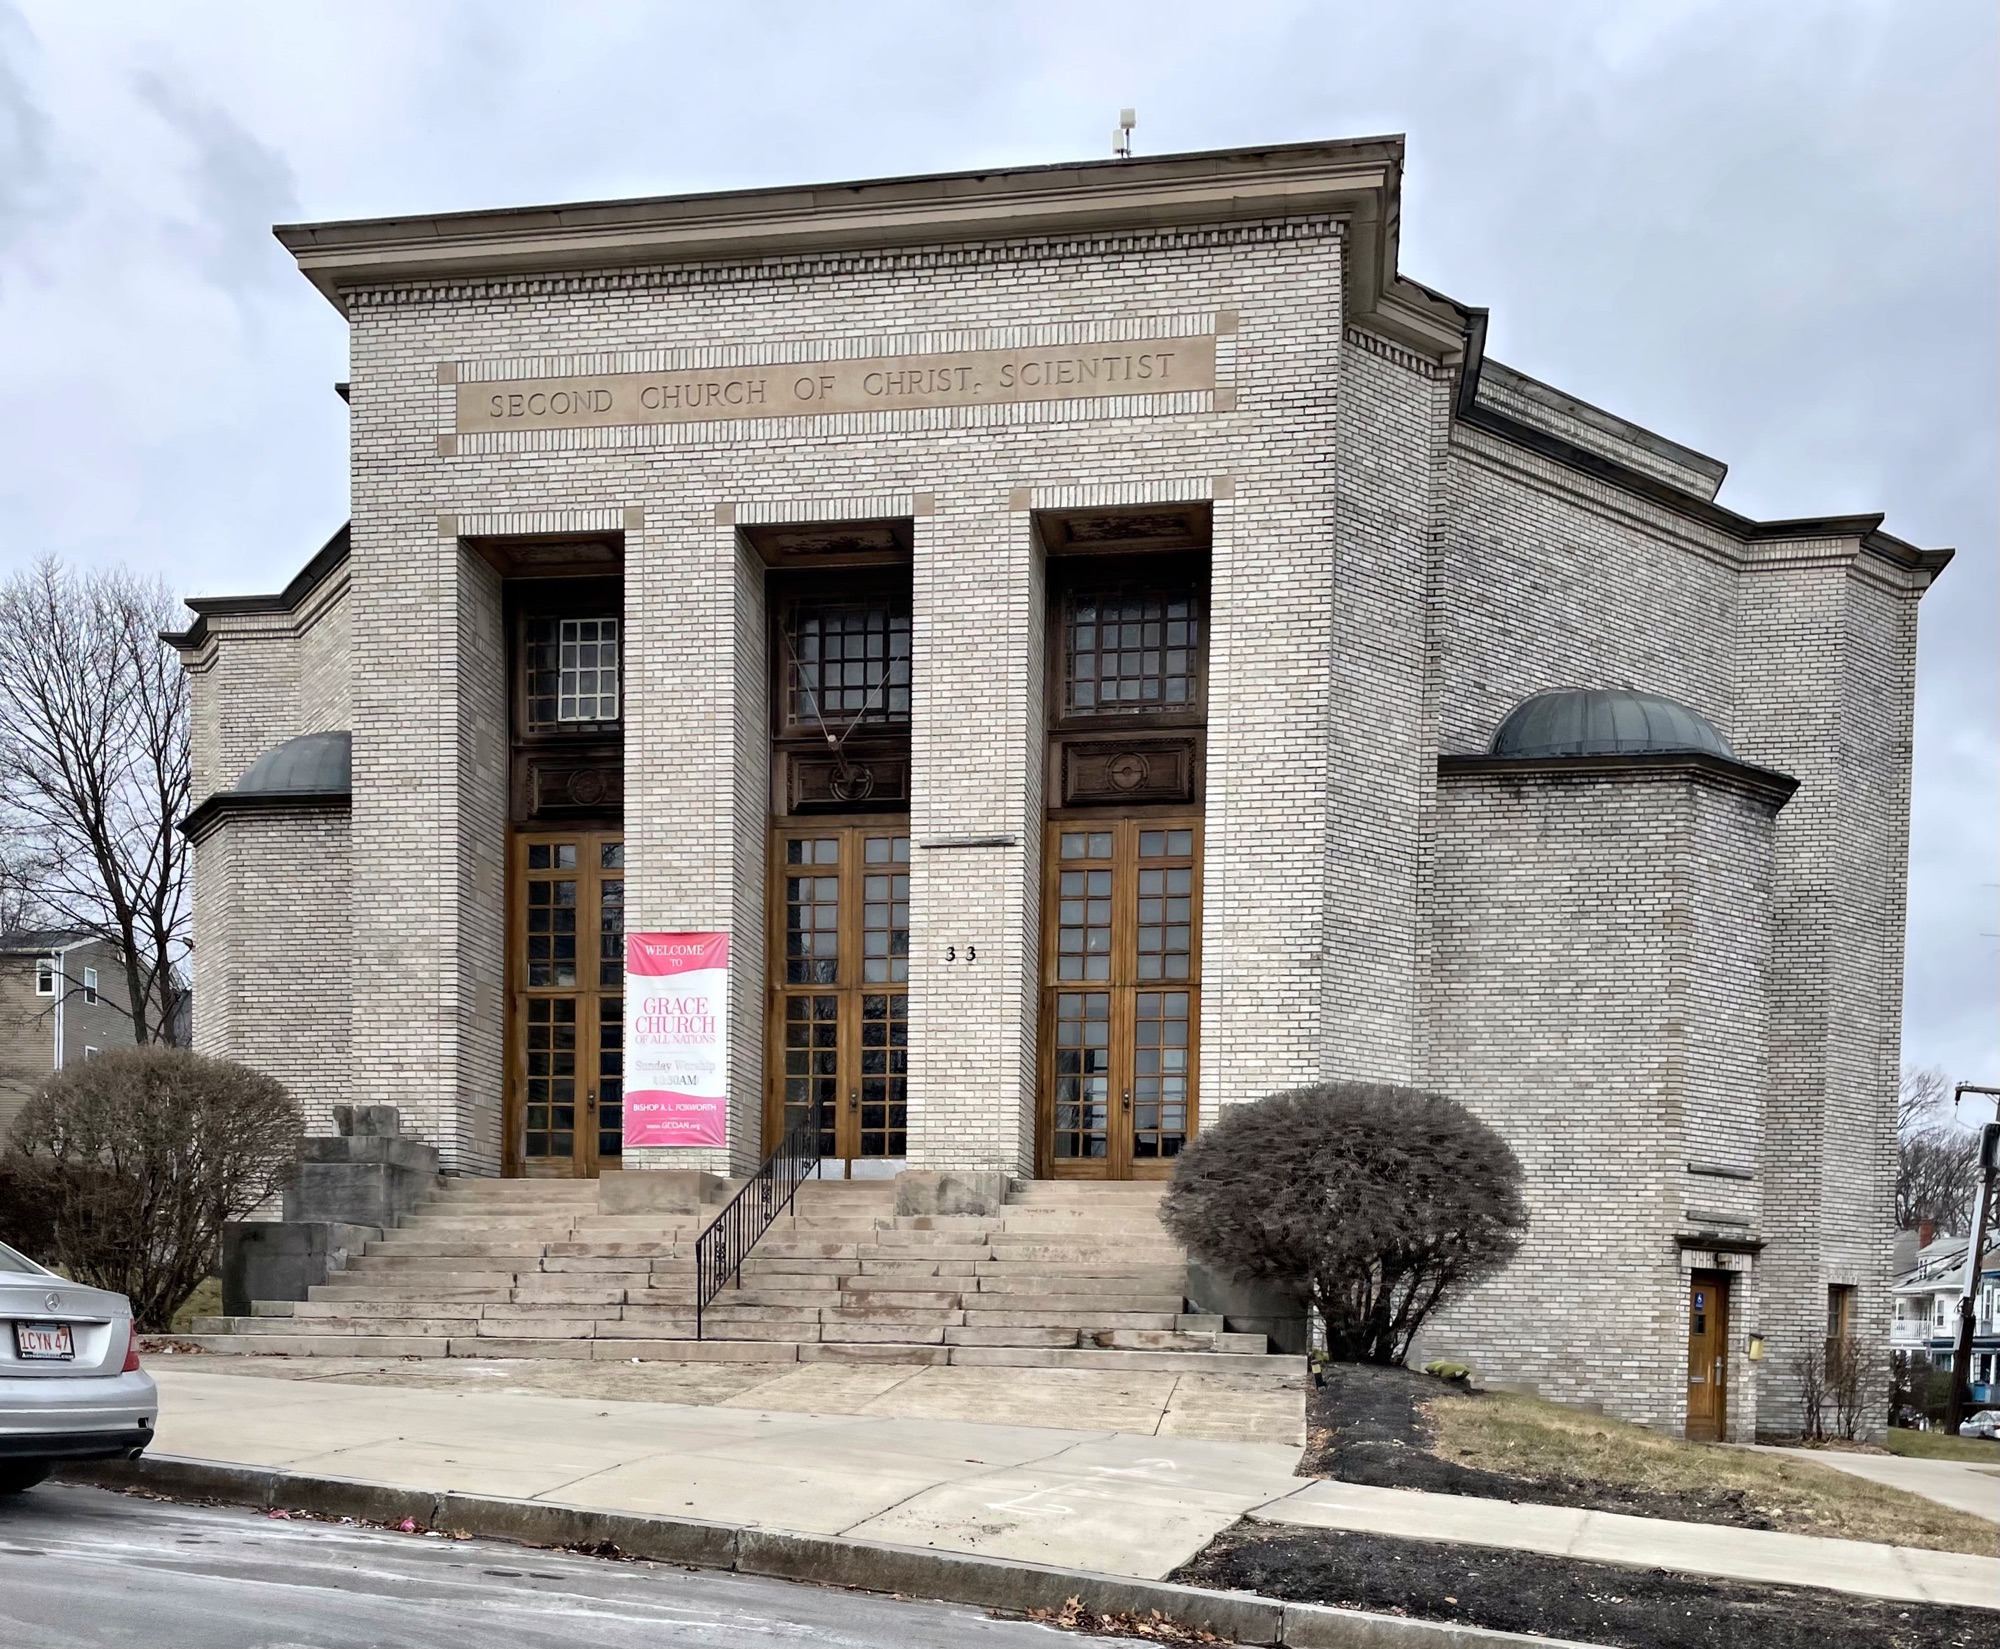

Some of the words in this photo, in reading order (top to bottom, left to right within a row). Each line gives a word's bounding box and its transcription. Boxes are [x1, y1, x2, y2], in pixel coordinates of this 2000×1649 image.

[489, 389, 614, 418] SECOND
[640, 380, 767, 410] CHURCH
[794, 376, 836, 401] OF
[999, 353, 1176, 388] SCIENTIST
[645, 945, 705, 956] WELCOME
[670, 959, 683, 967] TO
[643, 997, 708, 1015] GRACE
[635, 1016, 716, 1033] CHURCH
[635, 1035, 649, 1044] OF
[651, 1035, 670, 1044] ALL
[673, 1035, 716, 1044] NATIONS
[635, 1061, 672, 1073] Sunday
[20, 1332, 52, 1350] 1CYN
